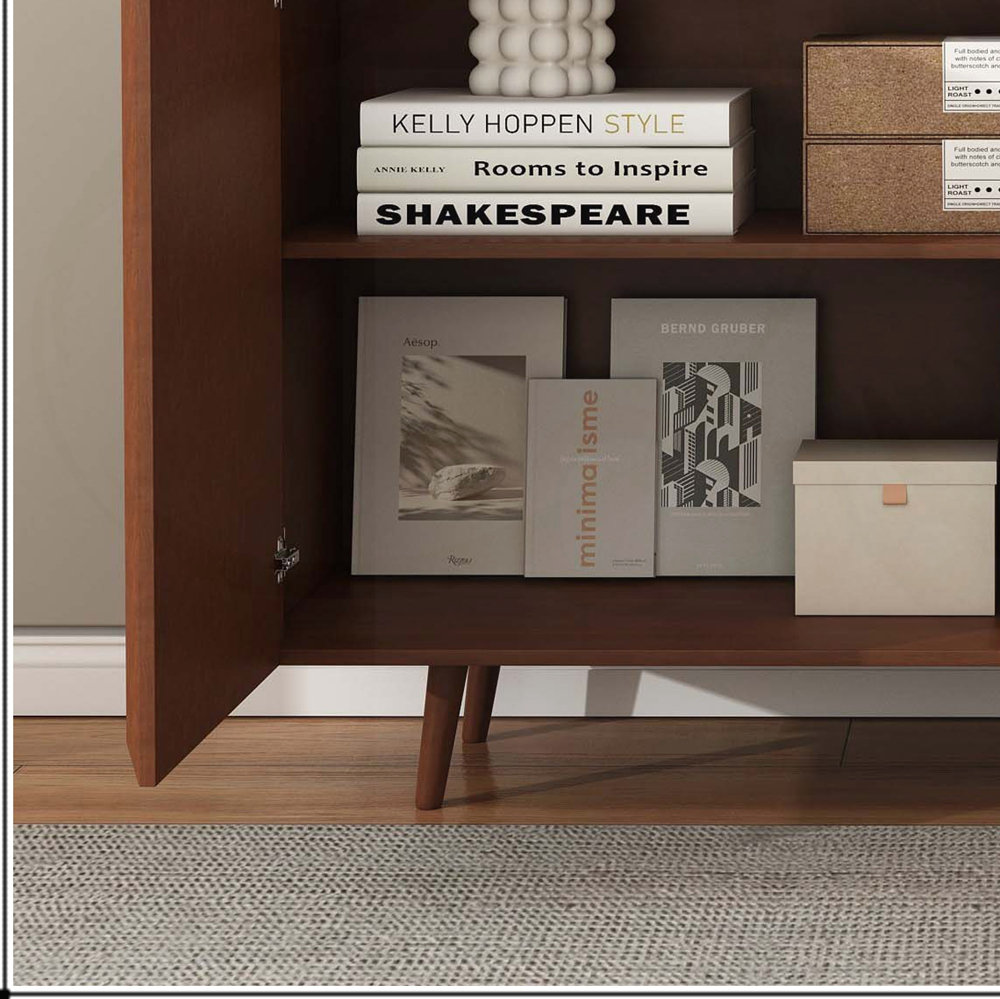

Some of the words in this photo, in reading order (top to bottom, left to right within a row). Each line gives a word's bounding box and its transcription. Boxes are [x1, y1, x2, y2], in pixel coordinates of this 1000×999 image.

[392, 113, 475, 134] KELLY
[485, 113, 593, 134] HOPPEN
[605, 113, 685, 134] STYLE
[474, 160, 566, 177] Rooms
[576, 161, 604, 177] to
[613, 160, 708, 181] Inspire
[375, 203, 691, 226] SHAKESPEARE
[661, 323, 706, 334] BERND
[711, 323, 765, 334] GRUBER
